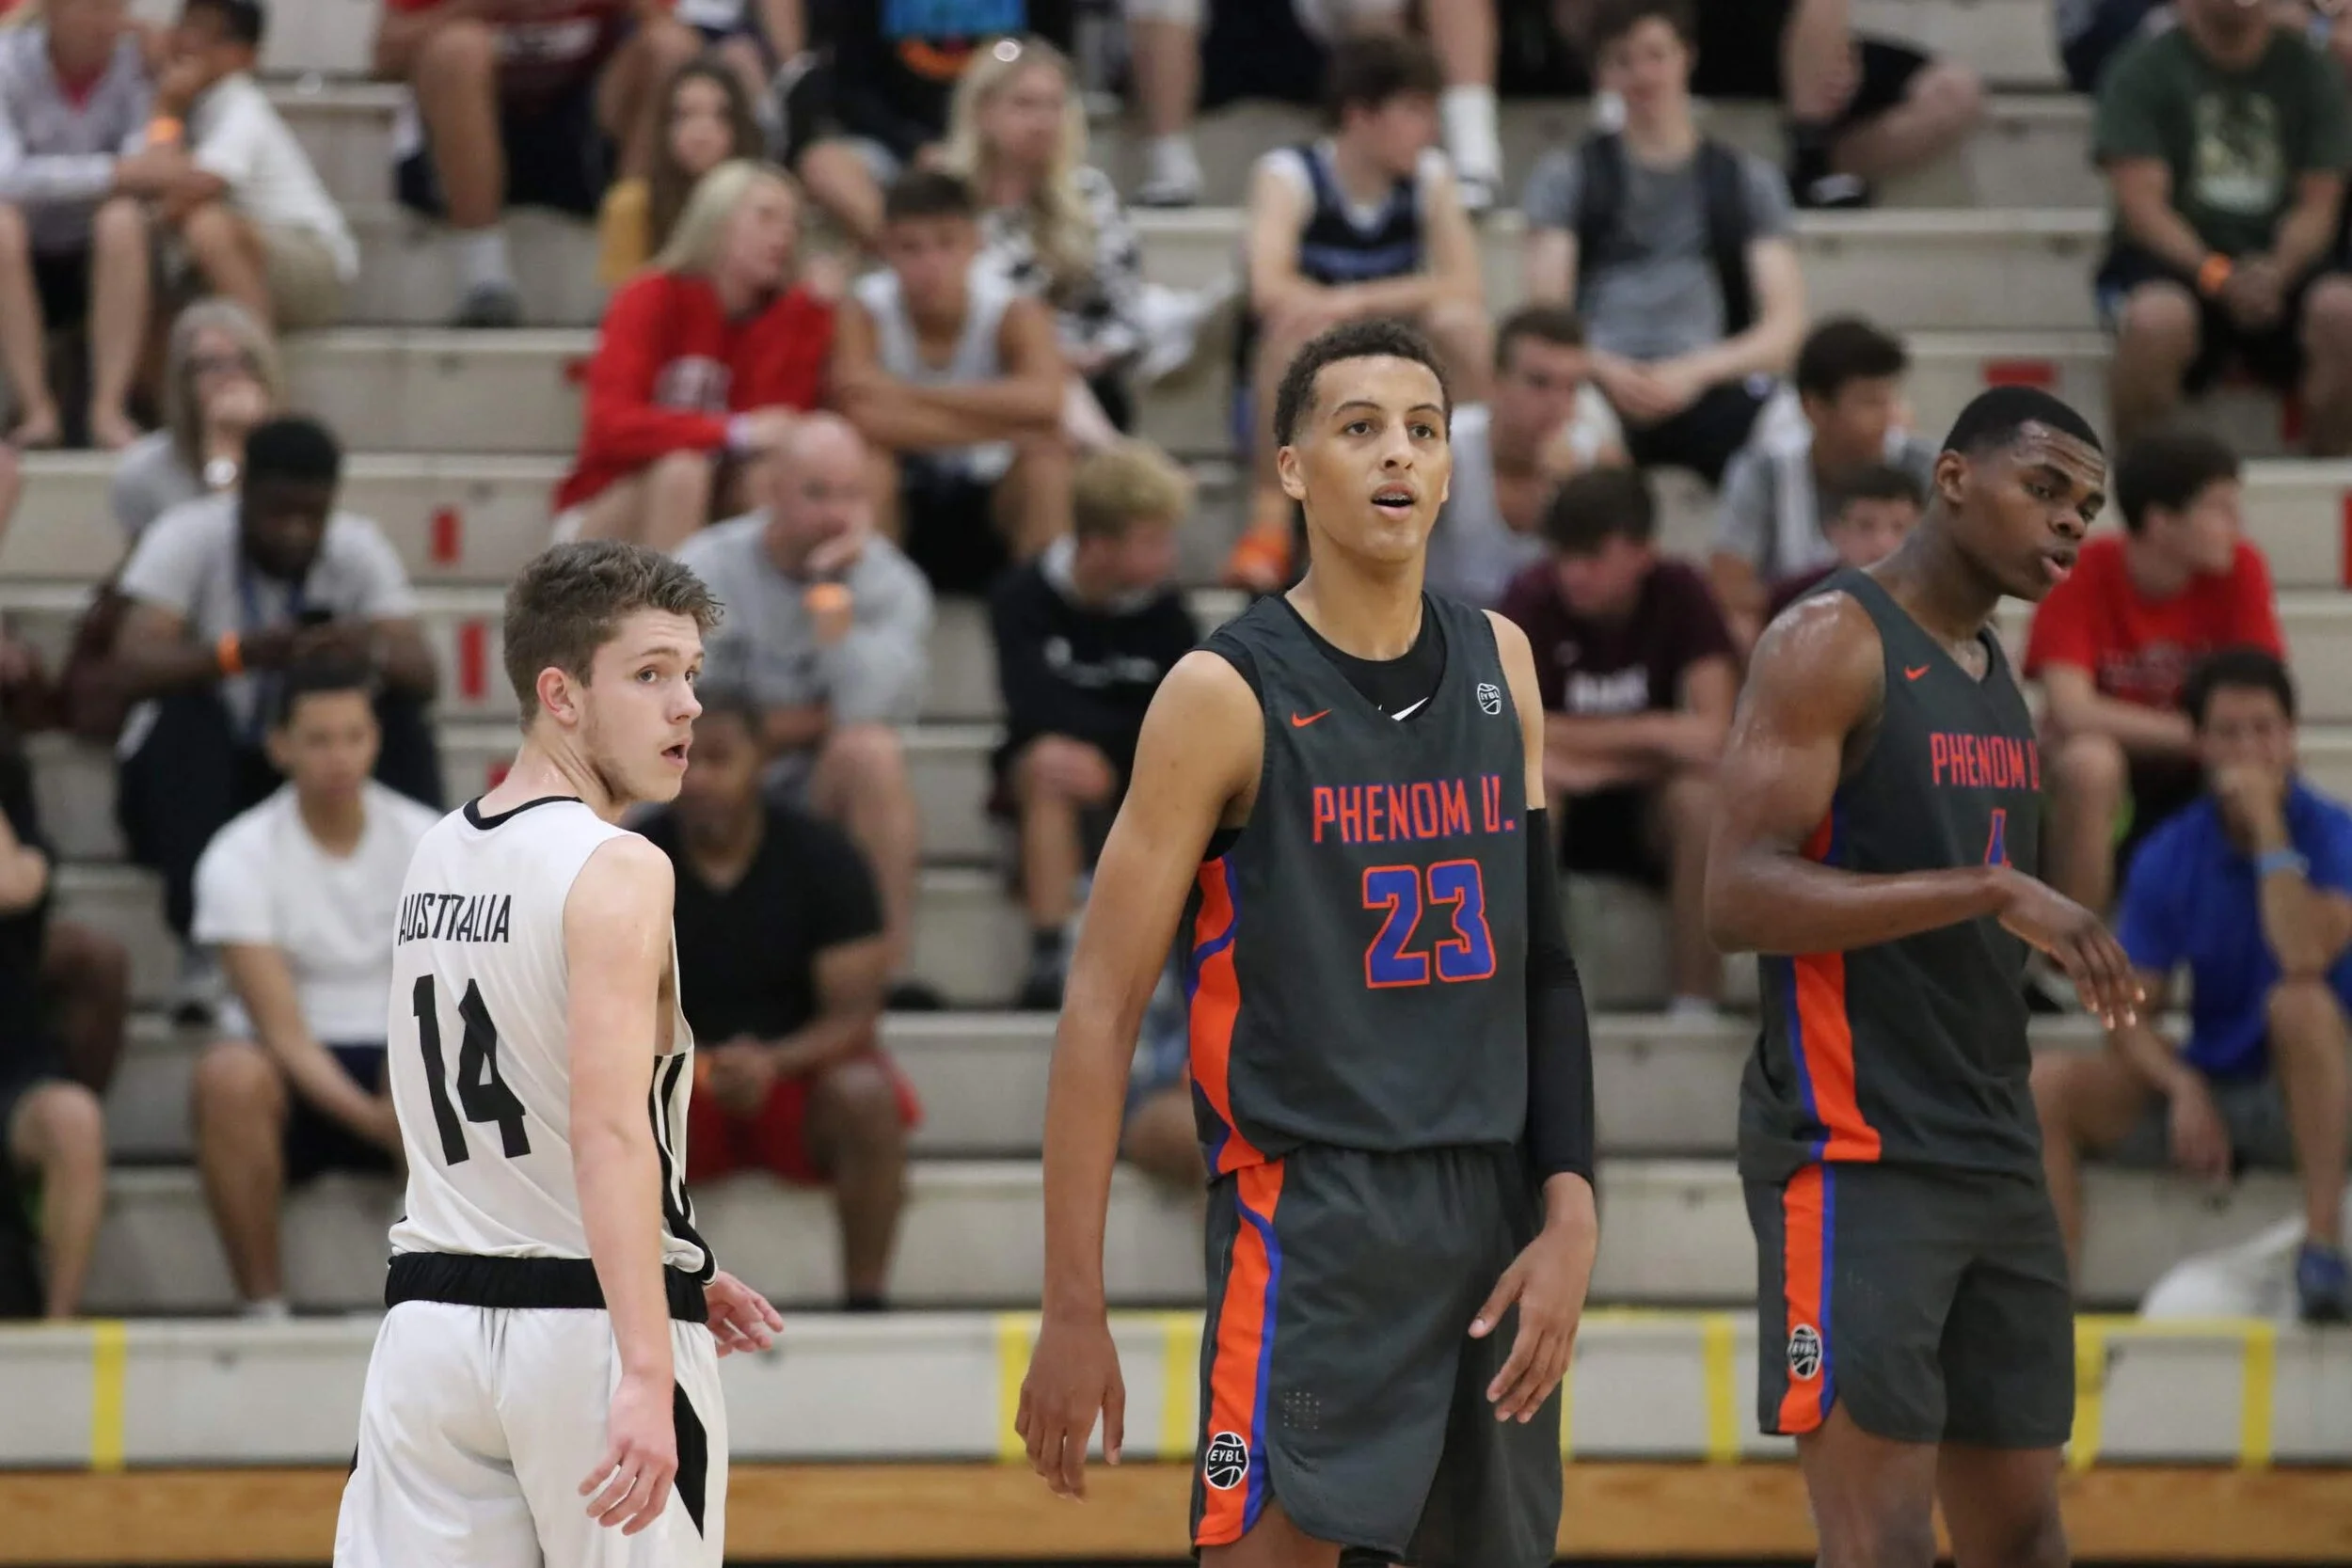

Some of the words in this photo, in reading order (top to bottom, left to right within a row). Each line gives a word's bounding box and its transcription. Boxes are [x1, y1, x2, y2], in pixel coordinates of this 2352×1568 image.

[1930, 732, 2027, 791] PHENOM
[1312, 777, 1473, 844] PHENOM
[1481, 773, 1516, 833] U.
[398, 893, 512, 946] AUSTRALIA
[1362, 858, 1497, 989] 23
[412, 974, 532, 1166] 14
[1210, 1449, 1244, 1463] EYBL
